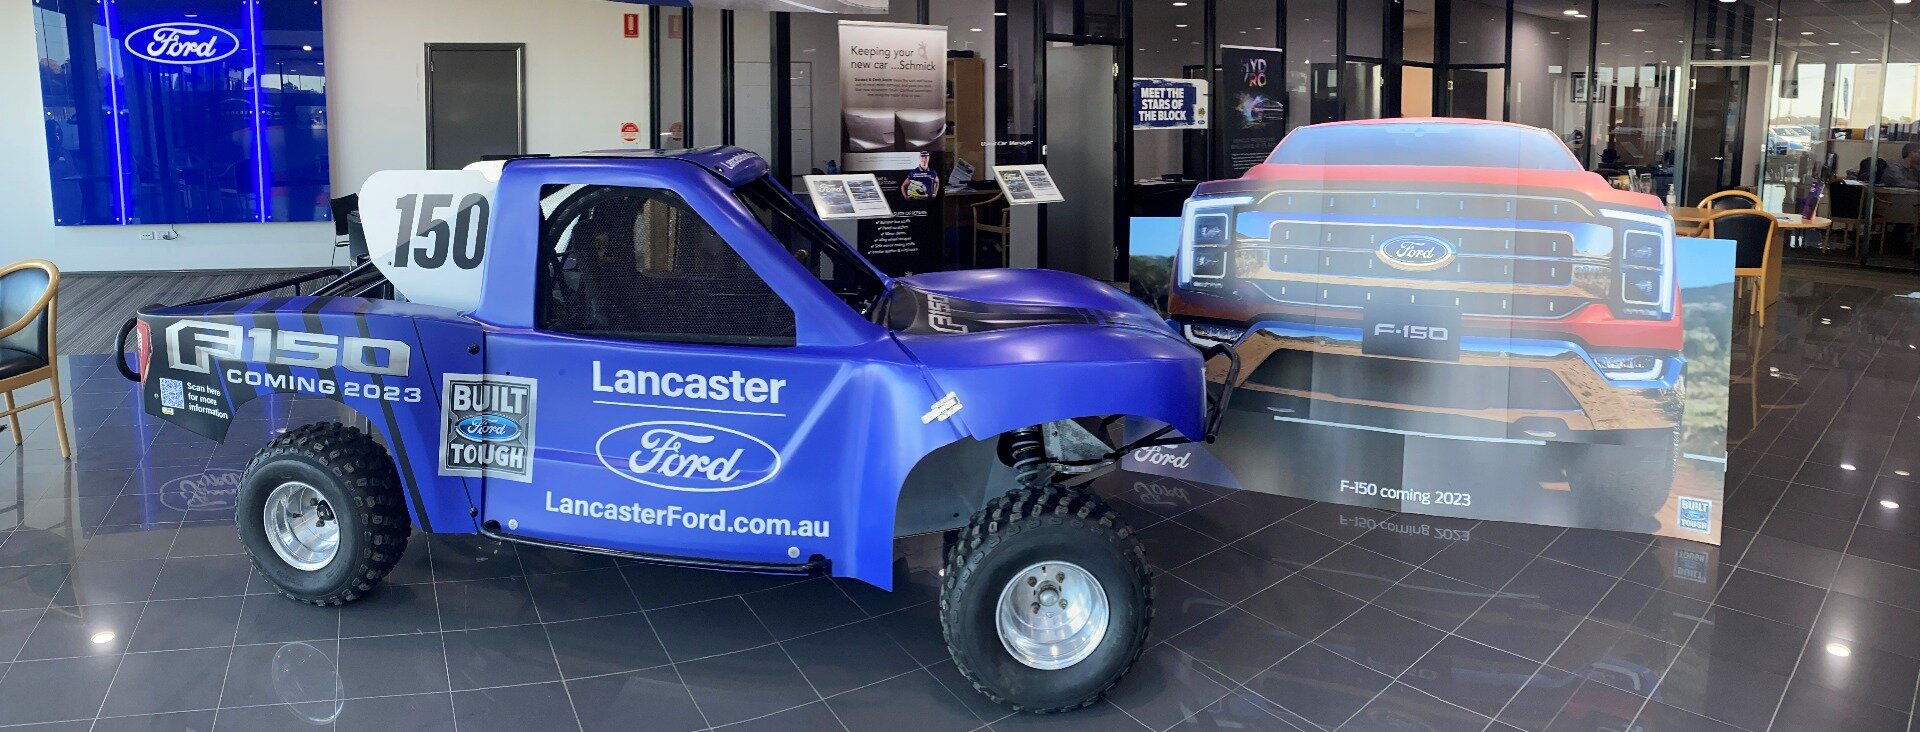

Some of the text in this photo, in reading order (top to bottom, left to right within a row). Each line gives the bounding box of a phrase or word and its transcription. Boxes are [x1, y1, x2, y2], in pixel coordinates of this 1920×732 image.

[147, 27, 217, 57] Ford
[850, 45, 914, 60] Keeping your
[850, 61, 870, 69] new
[1141, 87, 1184, 99] MEET THE
[1141, 99, 1184, 110] STARS OF
[1138, 110, 1186, 121] THE BLOCK
[818, 183, 843, 193] Ford
[393, 193, 489, 270] 150
[1396, 241, 1435, 259] Ford
[1374, 323, 1448, 341] F-150
[186, 381, 221, 397] Scan here
[226, 369, 422, 403] COMING 2023
[592, 360, 786, 404] Lancaster
[187, 392, 217, 405] for more
[453, 384, 527, 414] BUILT
[188, 402, 228, 419] information
[467, 418, 506, 435] Ford
[450, 443, 524, 469] TOUGH
[628, 428, 745, 483] Ford
[1134, 444, 1191, 469] Ford
[1340, 479, 1471, 507] F-150 coming 2023
[545, 491, 830, 538] LancasterFord.com.au
[1681, 500, 1709, 512] BUILT
[1680, 518, 1708, 530] TOUGH
